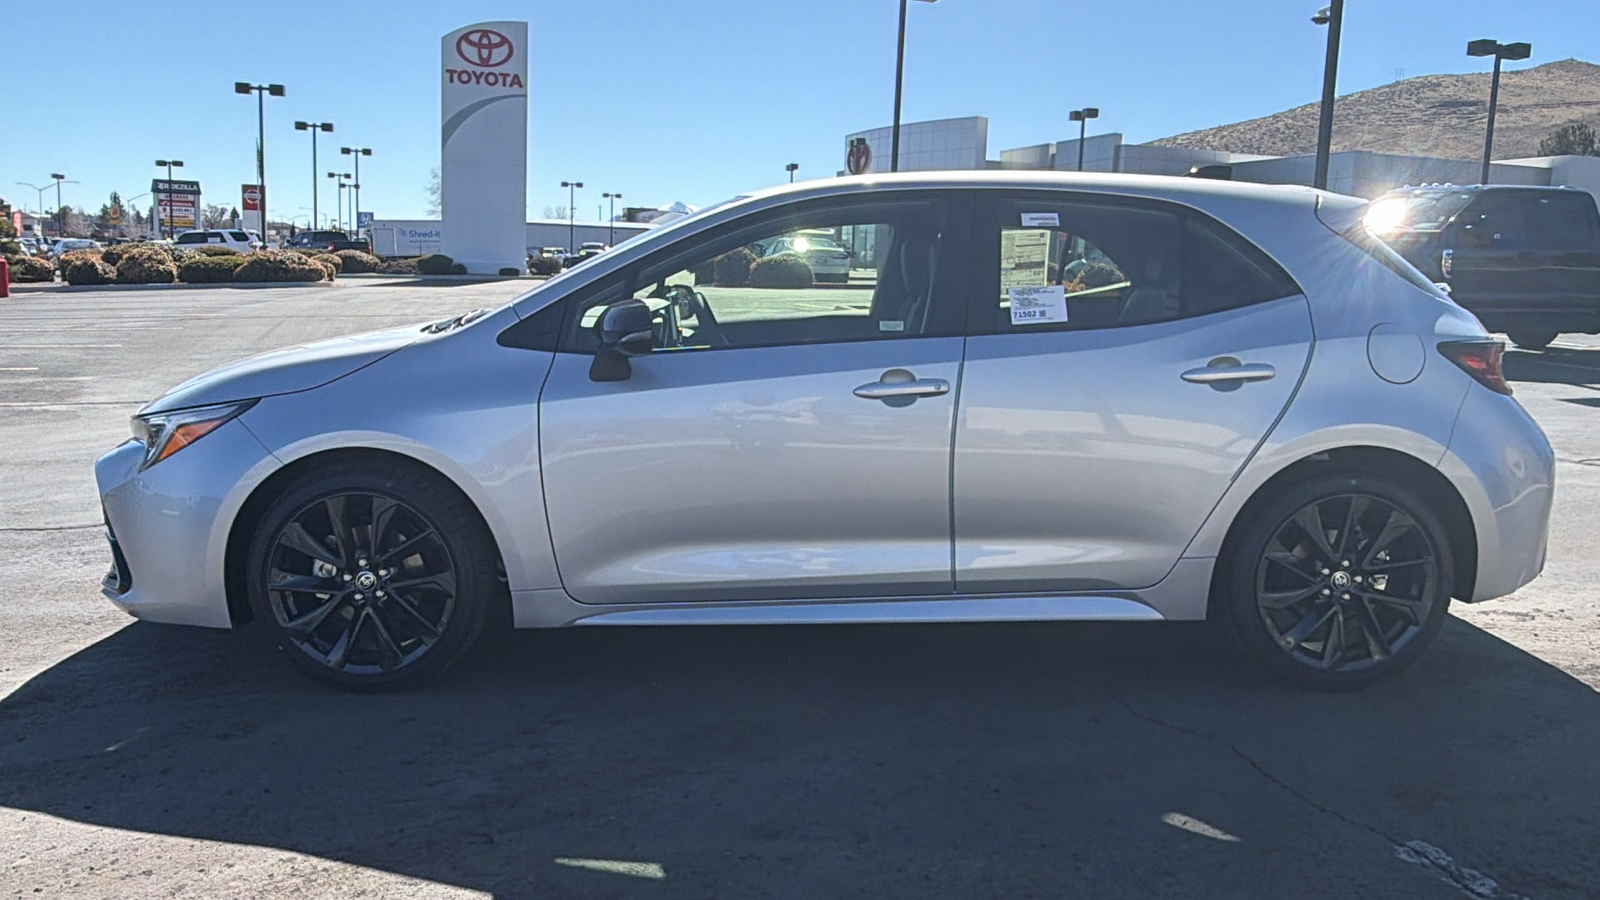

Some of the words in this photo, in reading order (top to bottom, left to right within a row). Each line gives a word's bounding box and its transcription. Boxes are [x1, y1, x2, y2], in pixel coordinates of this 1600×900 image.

[446, 69, 523, 88] TOYOTA
[164, 183, 198, 191] RDEZILLA
[409, 229, 441, 239] Shred-it
